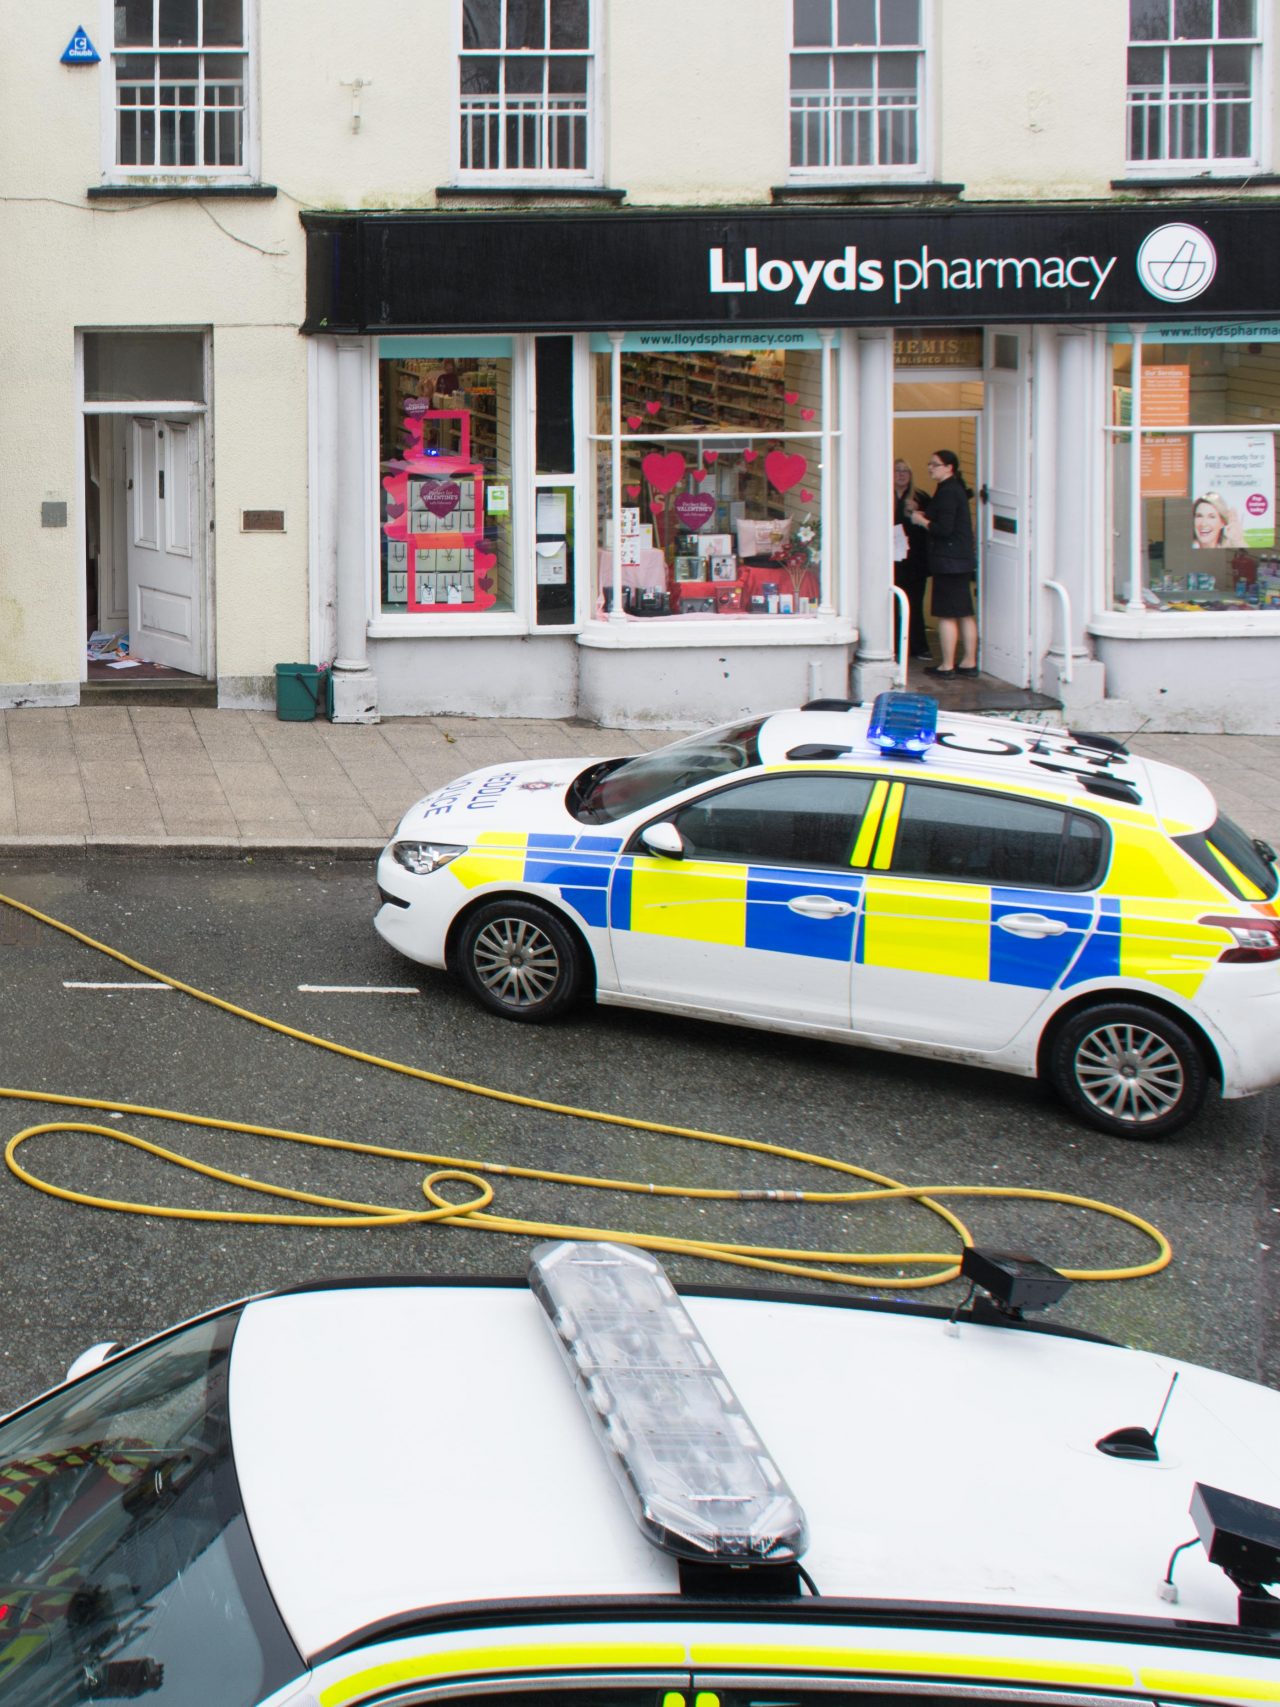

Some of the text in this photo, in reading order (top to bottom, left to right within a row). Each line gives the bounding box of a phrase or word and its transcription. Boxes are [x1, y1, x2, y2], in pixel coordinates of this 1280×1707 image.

[709, 246, 1117, 304] Lloyds pharmacy
[640, 333, 804, 346] www.lloydspharmacy.com
[423, 778, 474, 819] OLICE
